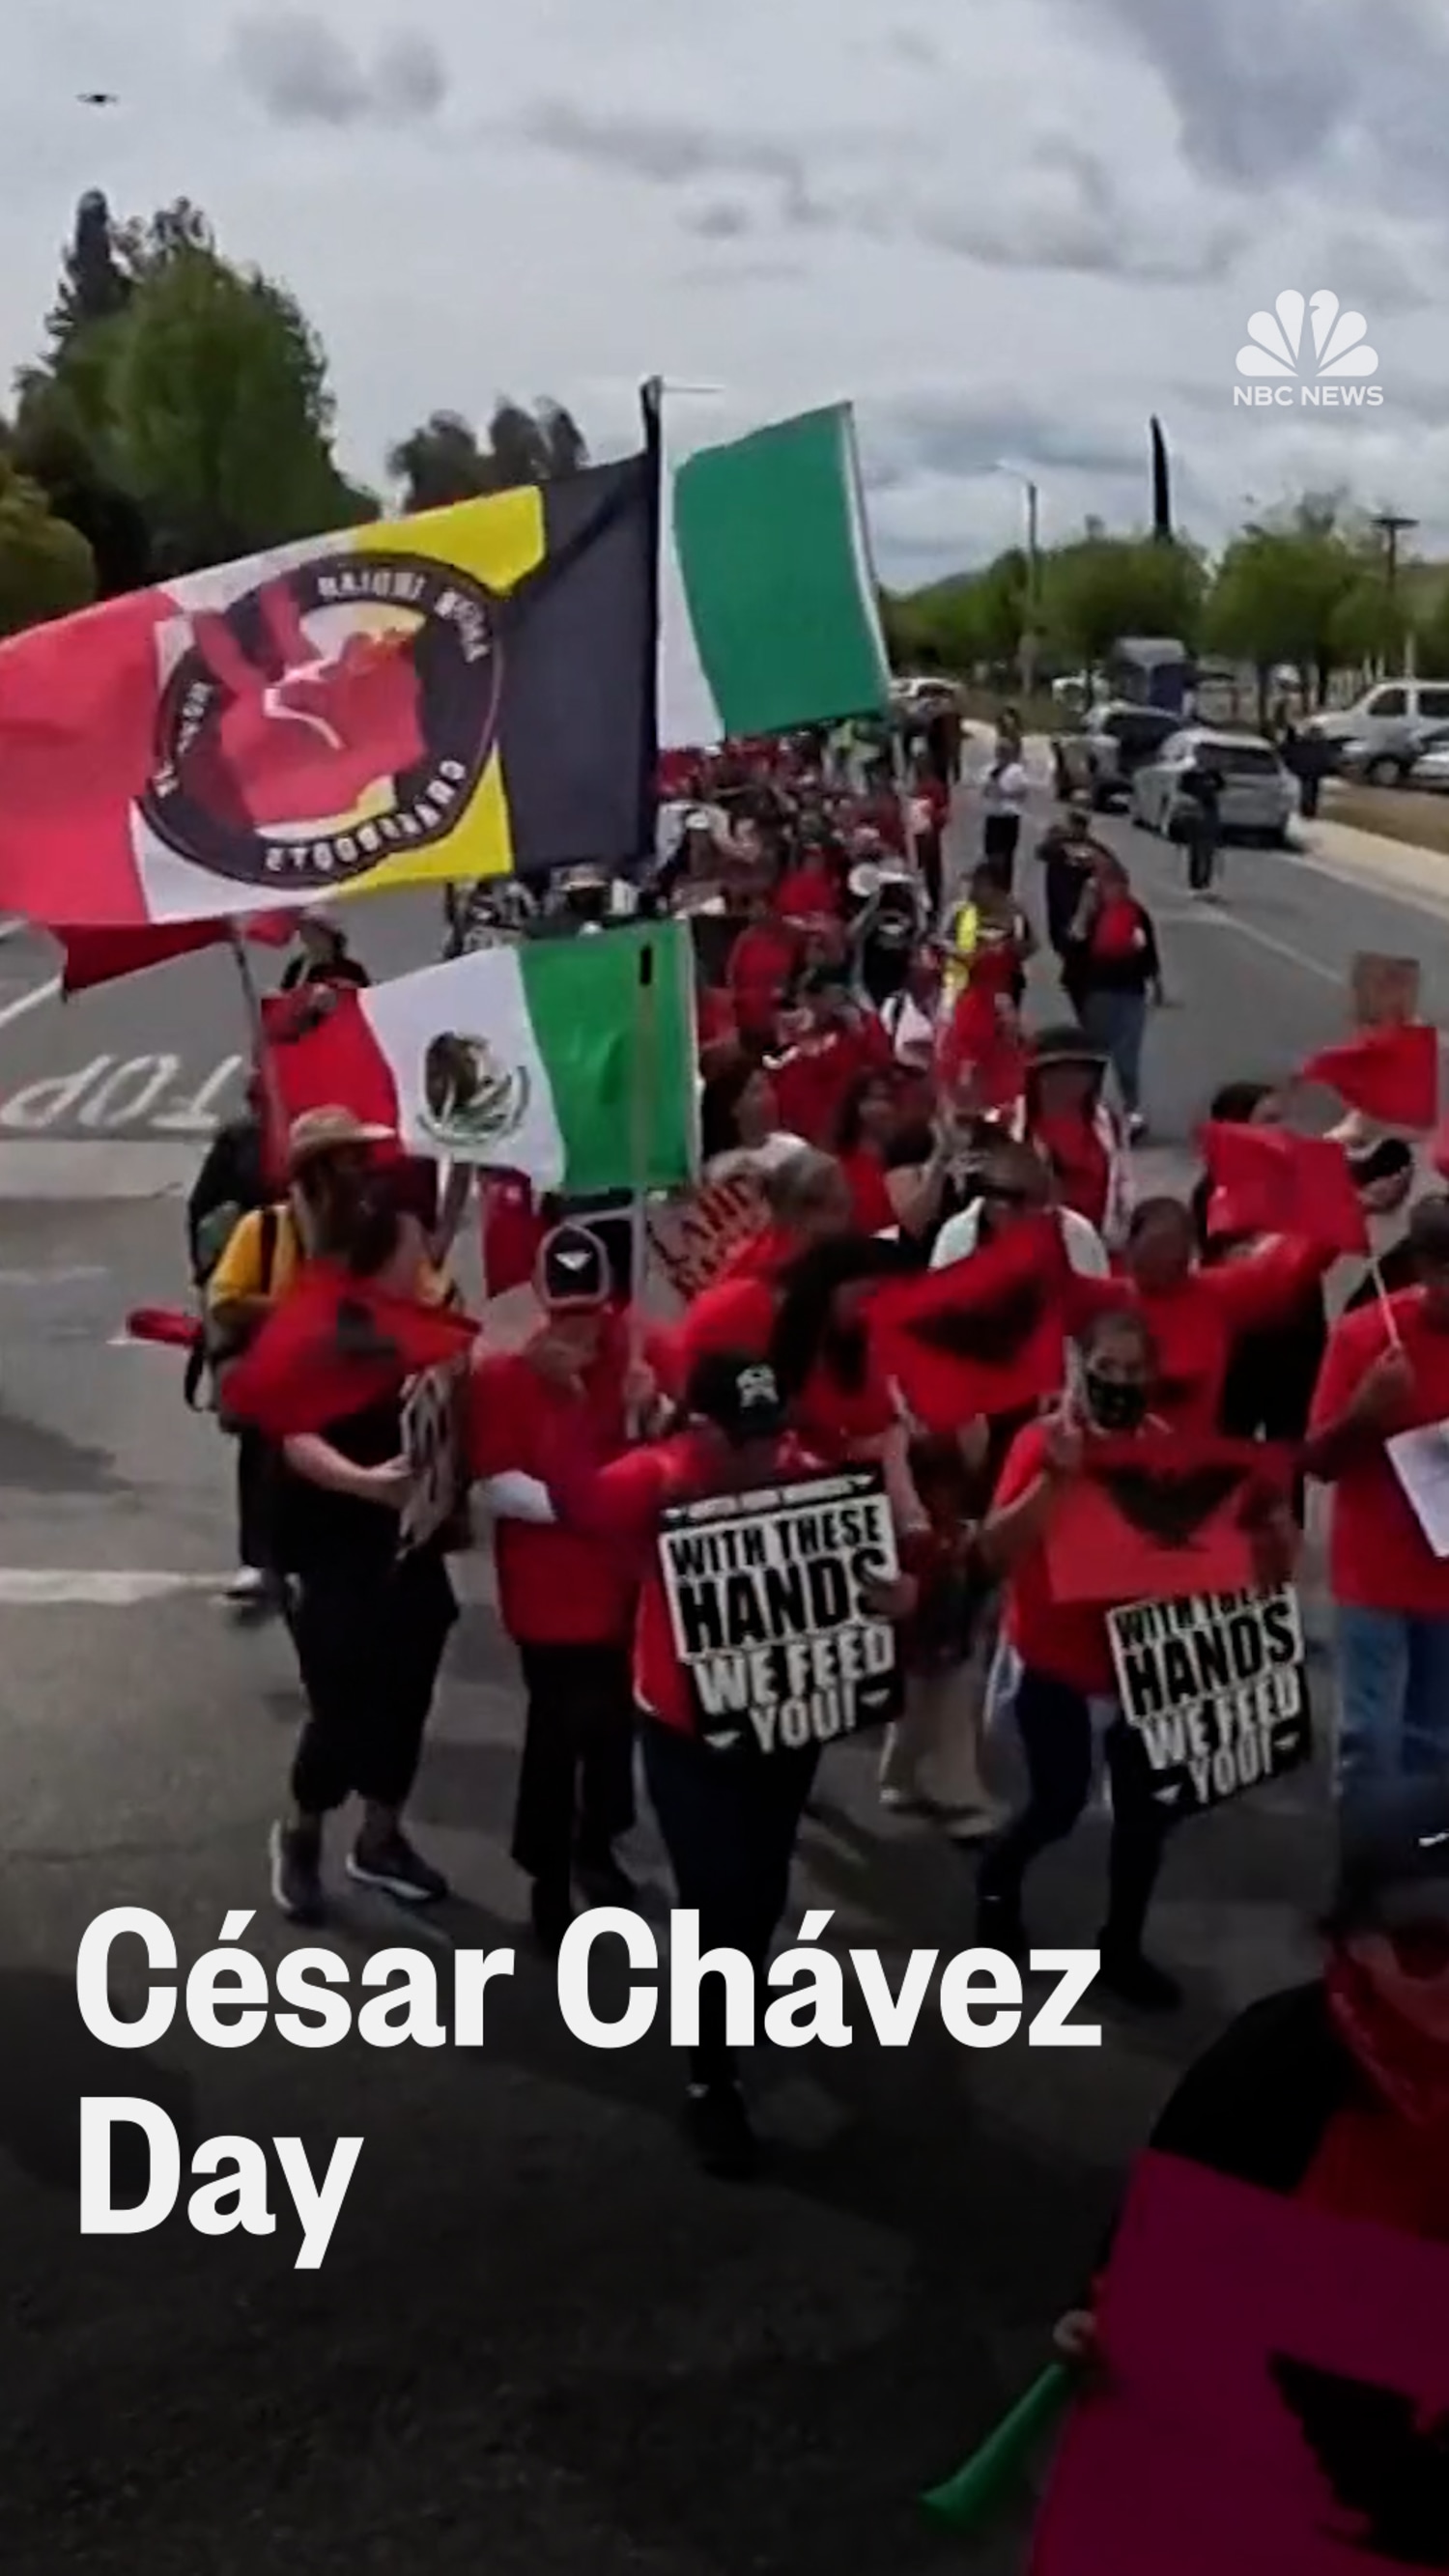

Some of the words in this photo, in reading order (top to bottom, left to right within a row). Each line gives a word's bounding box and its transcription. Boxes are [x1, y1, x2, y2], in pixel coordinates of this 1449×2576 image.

[0, 1054, 242, 1128] TOP
[669, 1526, 767, 1575] WITH
[777, 1505, 881, 1562] THESE
[677, 1548, 889, 1653] HANDS
[693, 1647, 779, 1715] WE
[784, 1624, 895, 1698] FEED
[1124, 1601, 1295, 1715] HANDS
[1139, 1707, 1211, 1770] WE
[1214, 1664, 1300, 1747] FEED
